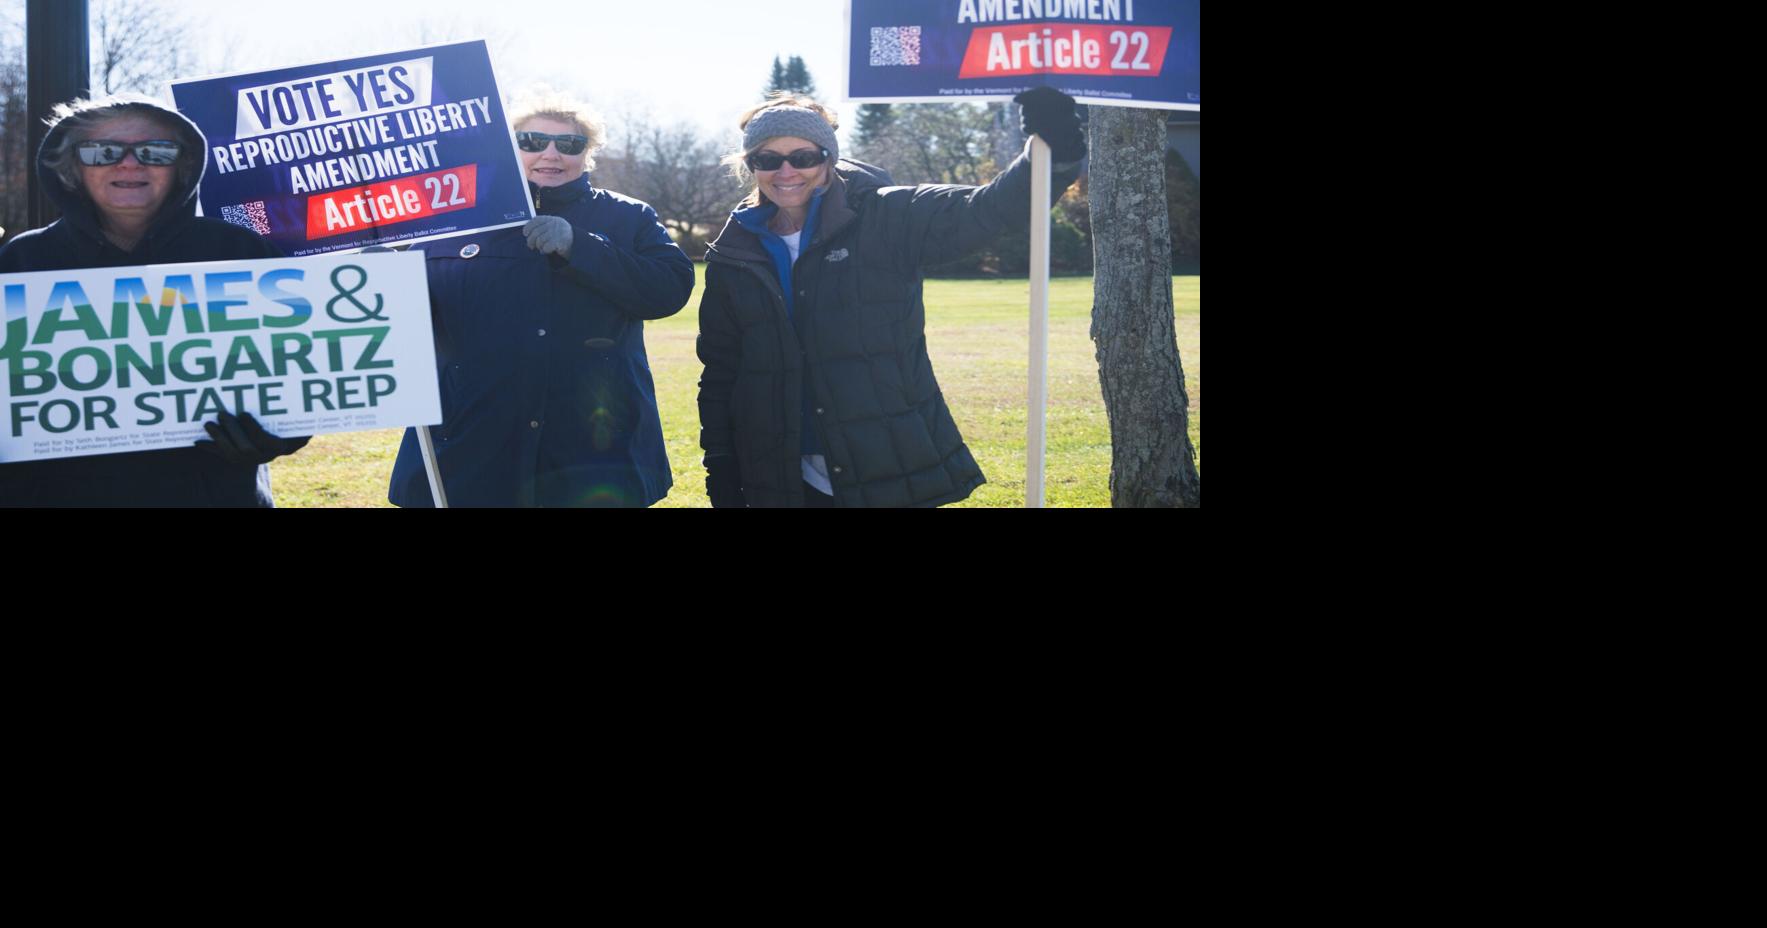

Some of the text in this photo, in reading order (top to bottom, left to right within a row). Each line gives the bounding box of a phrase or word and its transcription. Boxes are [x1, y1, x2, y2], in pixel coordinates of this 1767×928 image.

[957, 0, 1136, 23] AMENDMENT
[986, 28, 1152, 72] Article 22
[246, 65, 416, 130] VOTE YES
[212, 96, 492, 175] REPRODUCTIVE LIBERTY
[290, 139, 441, 195] AMENDMENT
[324, 172, 467, 231] Article 22
[331, 242, 353, 251] Vermont
[396, 232, 414, 241] Liberty
[0, 264, 390, 360] JAMES &
[9, 325, 394, 397] BONGARTZ
[11, 373, 397, 437] FOR STATE REP
